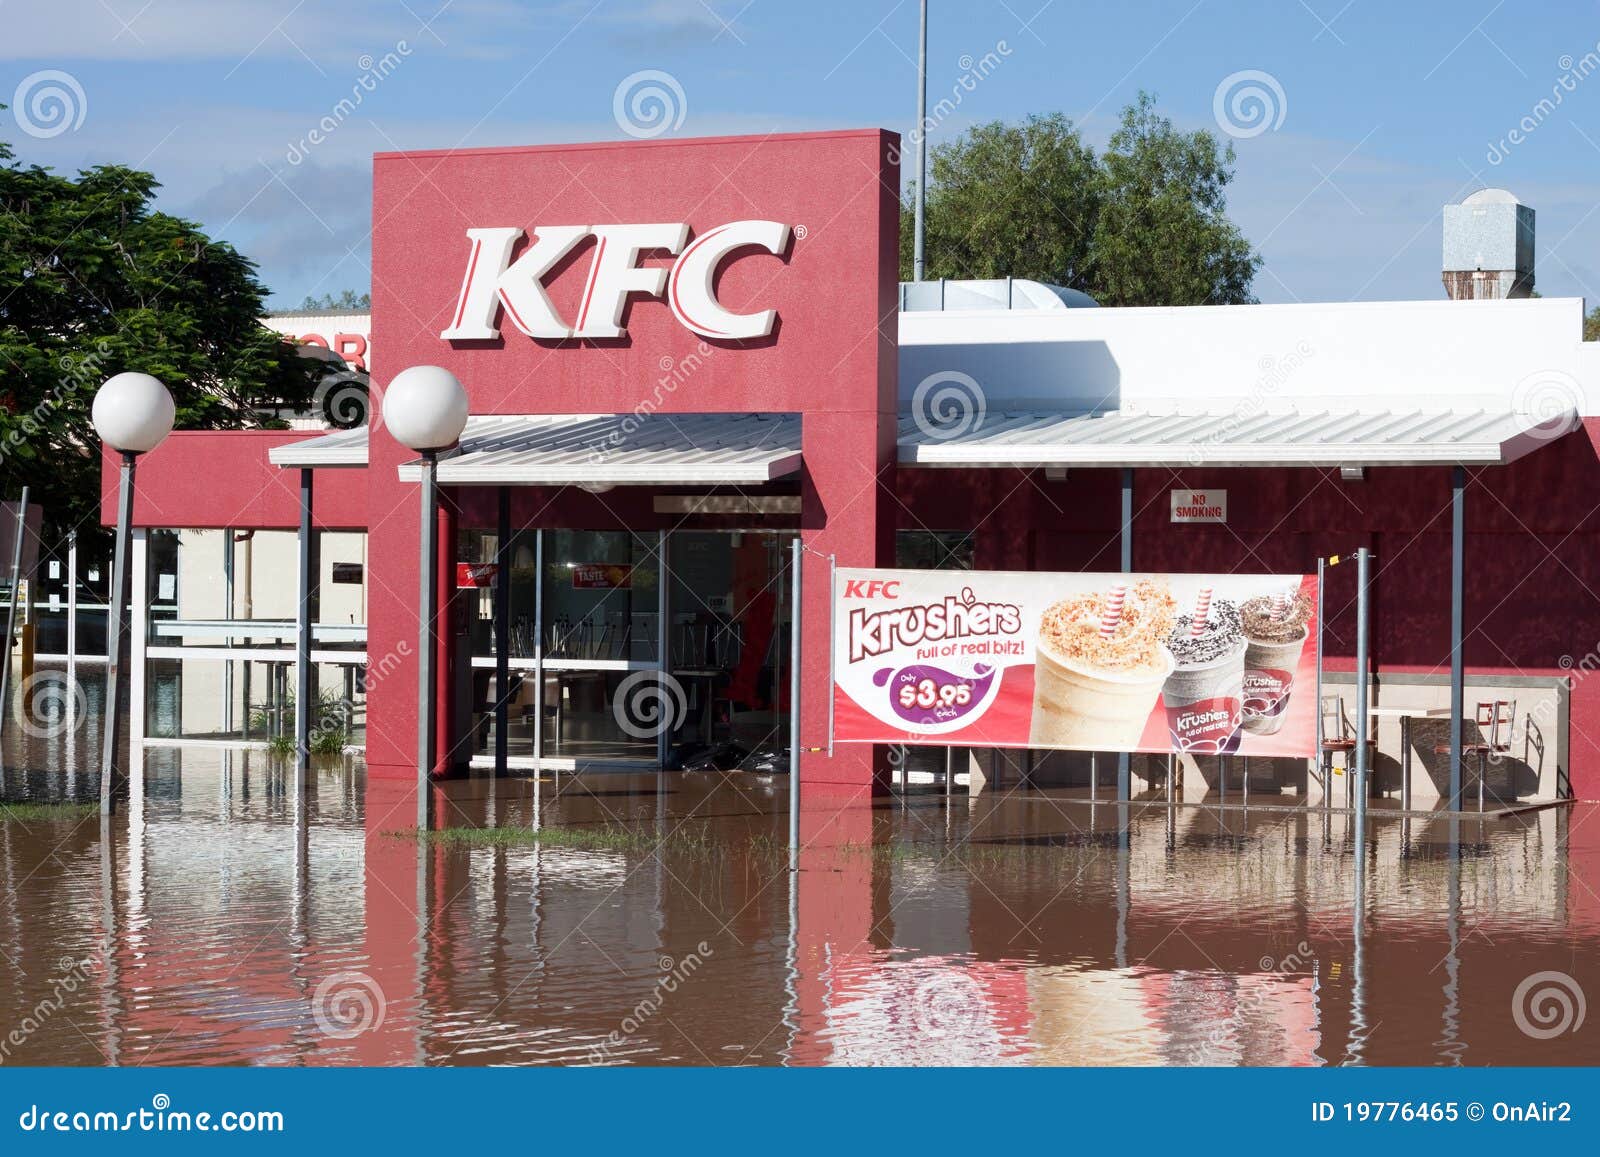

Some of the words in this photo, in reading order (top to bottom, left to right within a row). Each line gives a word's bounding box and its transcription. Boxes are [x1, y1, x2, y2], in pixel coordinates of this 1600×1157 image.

[440, 220, 791, 339] KFC
[1192, 494, 1206, 506] NO
[1176, 506, 1222, 518] SMOKING
[843, 580, 900, 599] KFC
[917, 646, 938, 660] full
[941, 643, 957, 656] of
[961, 641, 990, 655] real
[993, 640, 1024, 655] bitz!
[898, 678, 972, 710] $3.95
[936, 709, 957, 718] each
